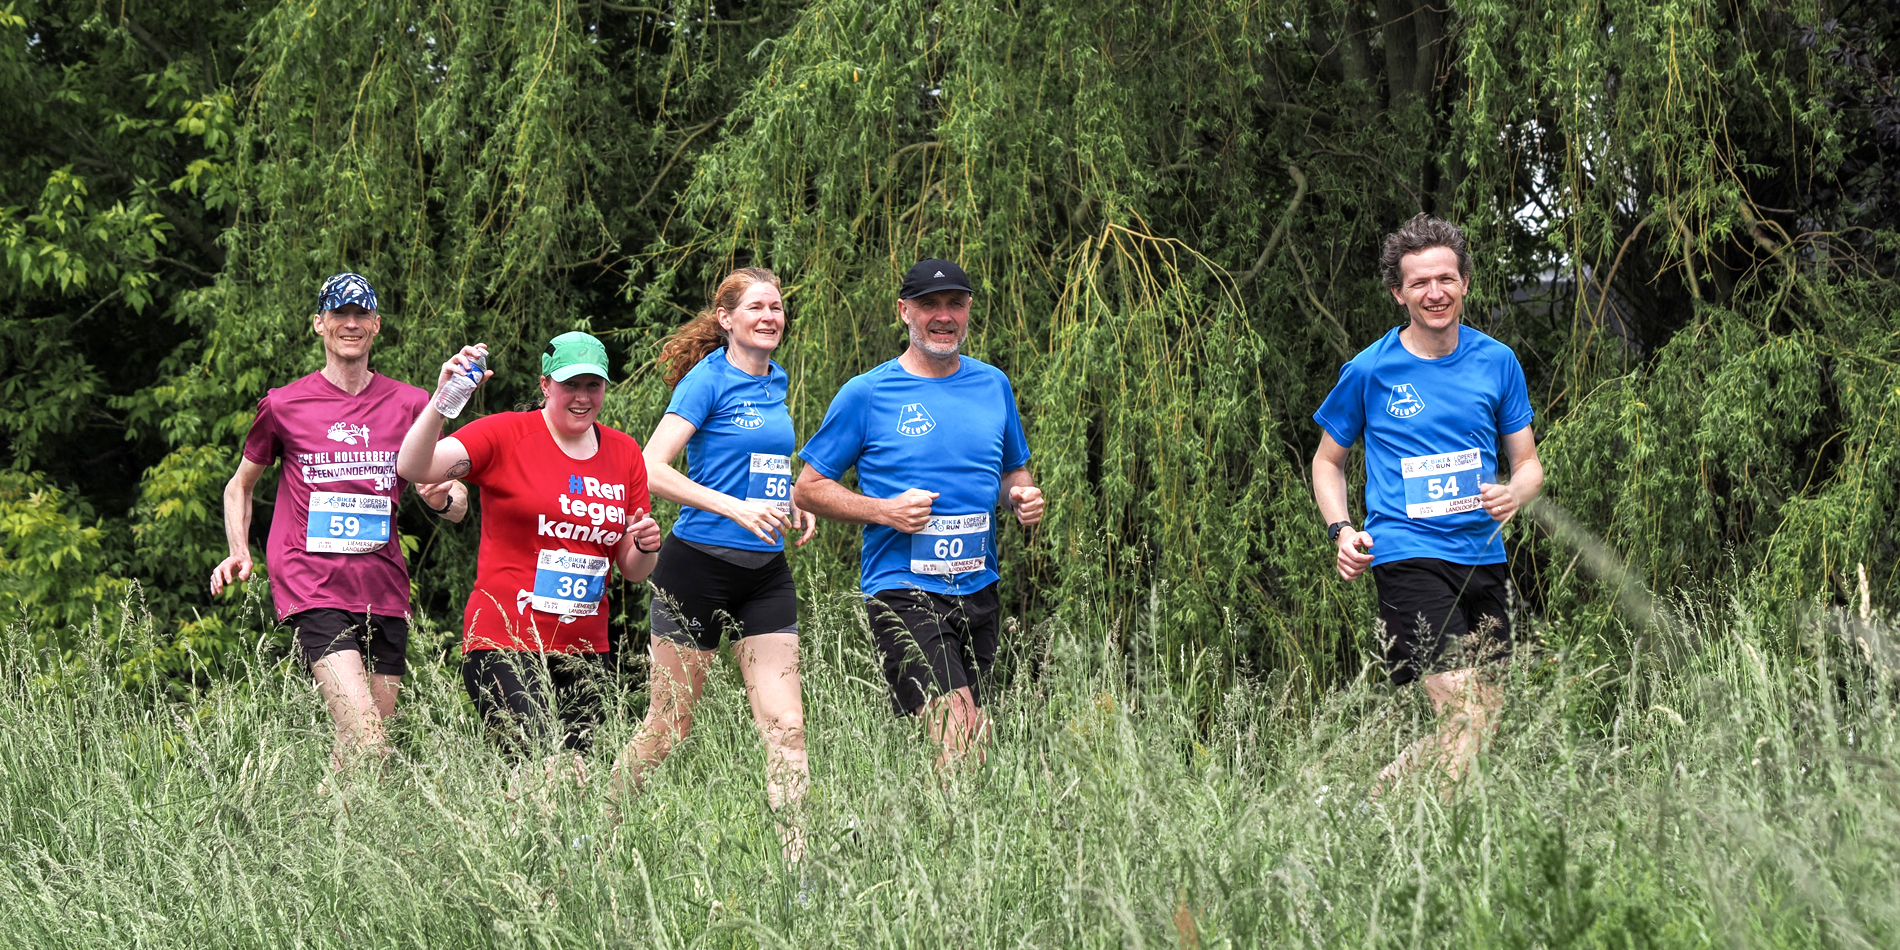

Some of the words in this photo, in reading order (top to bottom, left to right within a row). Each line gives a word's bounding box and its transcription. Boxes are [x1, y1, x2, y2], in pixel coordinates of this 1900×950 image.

[1390, 403, 1421, 416] VELUWE
[901, 421, 932, 434] VELUWE
[315, 452, 331, 464] HEL
[568, 474, 625, 501] #Ren
[765, 477, 787, 498] 56
[1427, 475, 1460, 499] 54
[558, 494, 625, 526] tegen
[1446, 504, 1473, 513] LANDLOOP
[329, 515, 360, 537] 59
[934, 538, 964, 559] 60
[556, 576, 588, 599] 36
